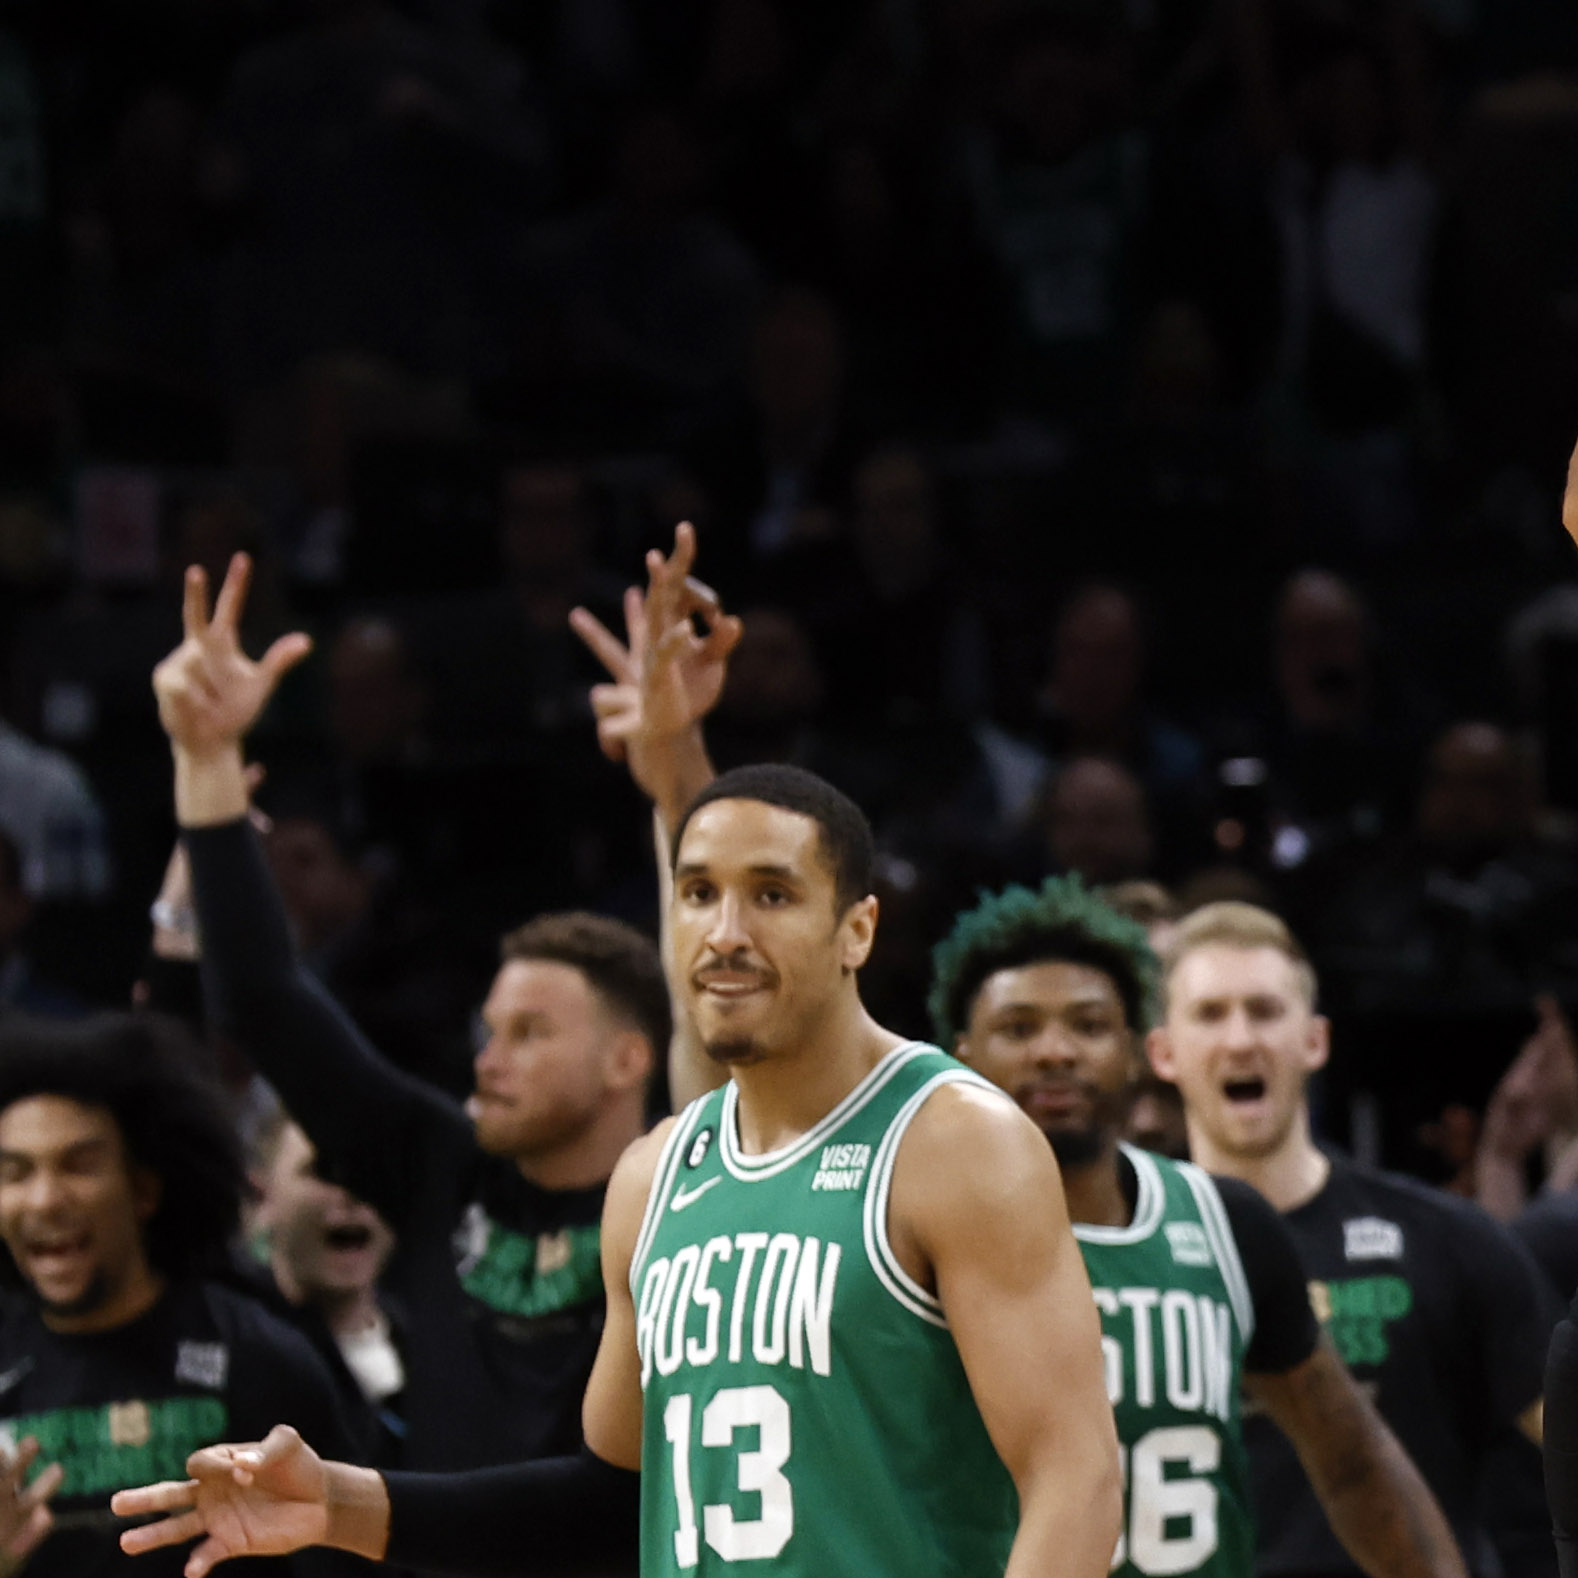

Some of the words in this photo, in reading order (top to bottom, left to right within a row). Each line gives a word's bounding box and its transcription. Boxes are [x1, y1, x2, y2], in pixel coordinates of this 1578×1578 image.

[688, 1129, 711, 1168] 6
[812, 1169, 863, 1192] PRINT
[820, 1143, 871, 1169] VISTA
[637, 1232, 842, 1391] BOSTON
[663, 1384, 794, 1570] 13
[1110, 1423, 1222, 1576] 6
